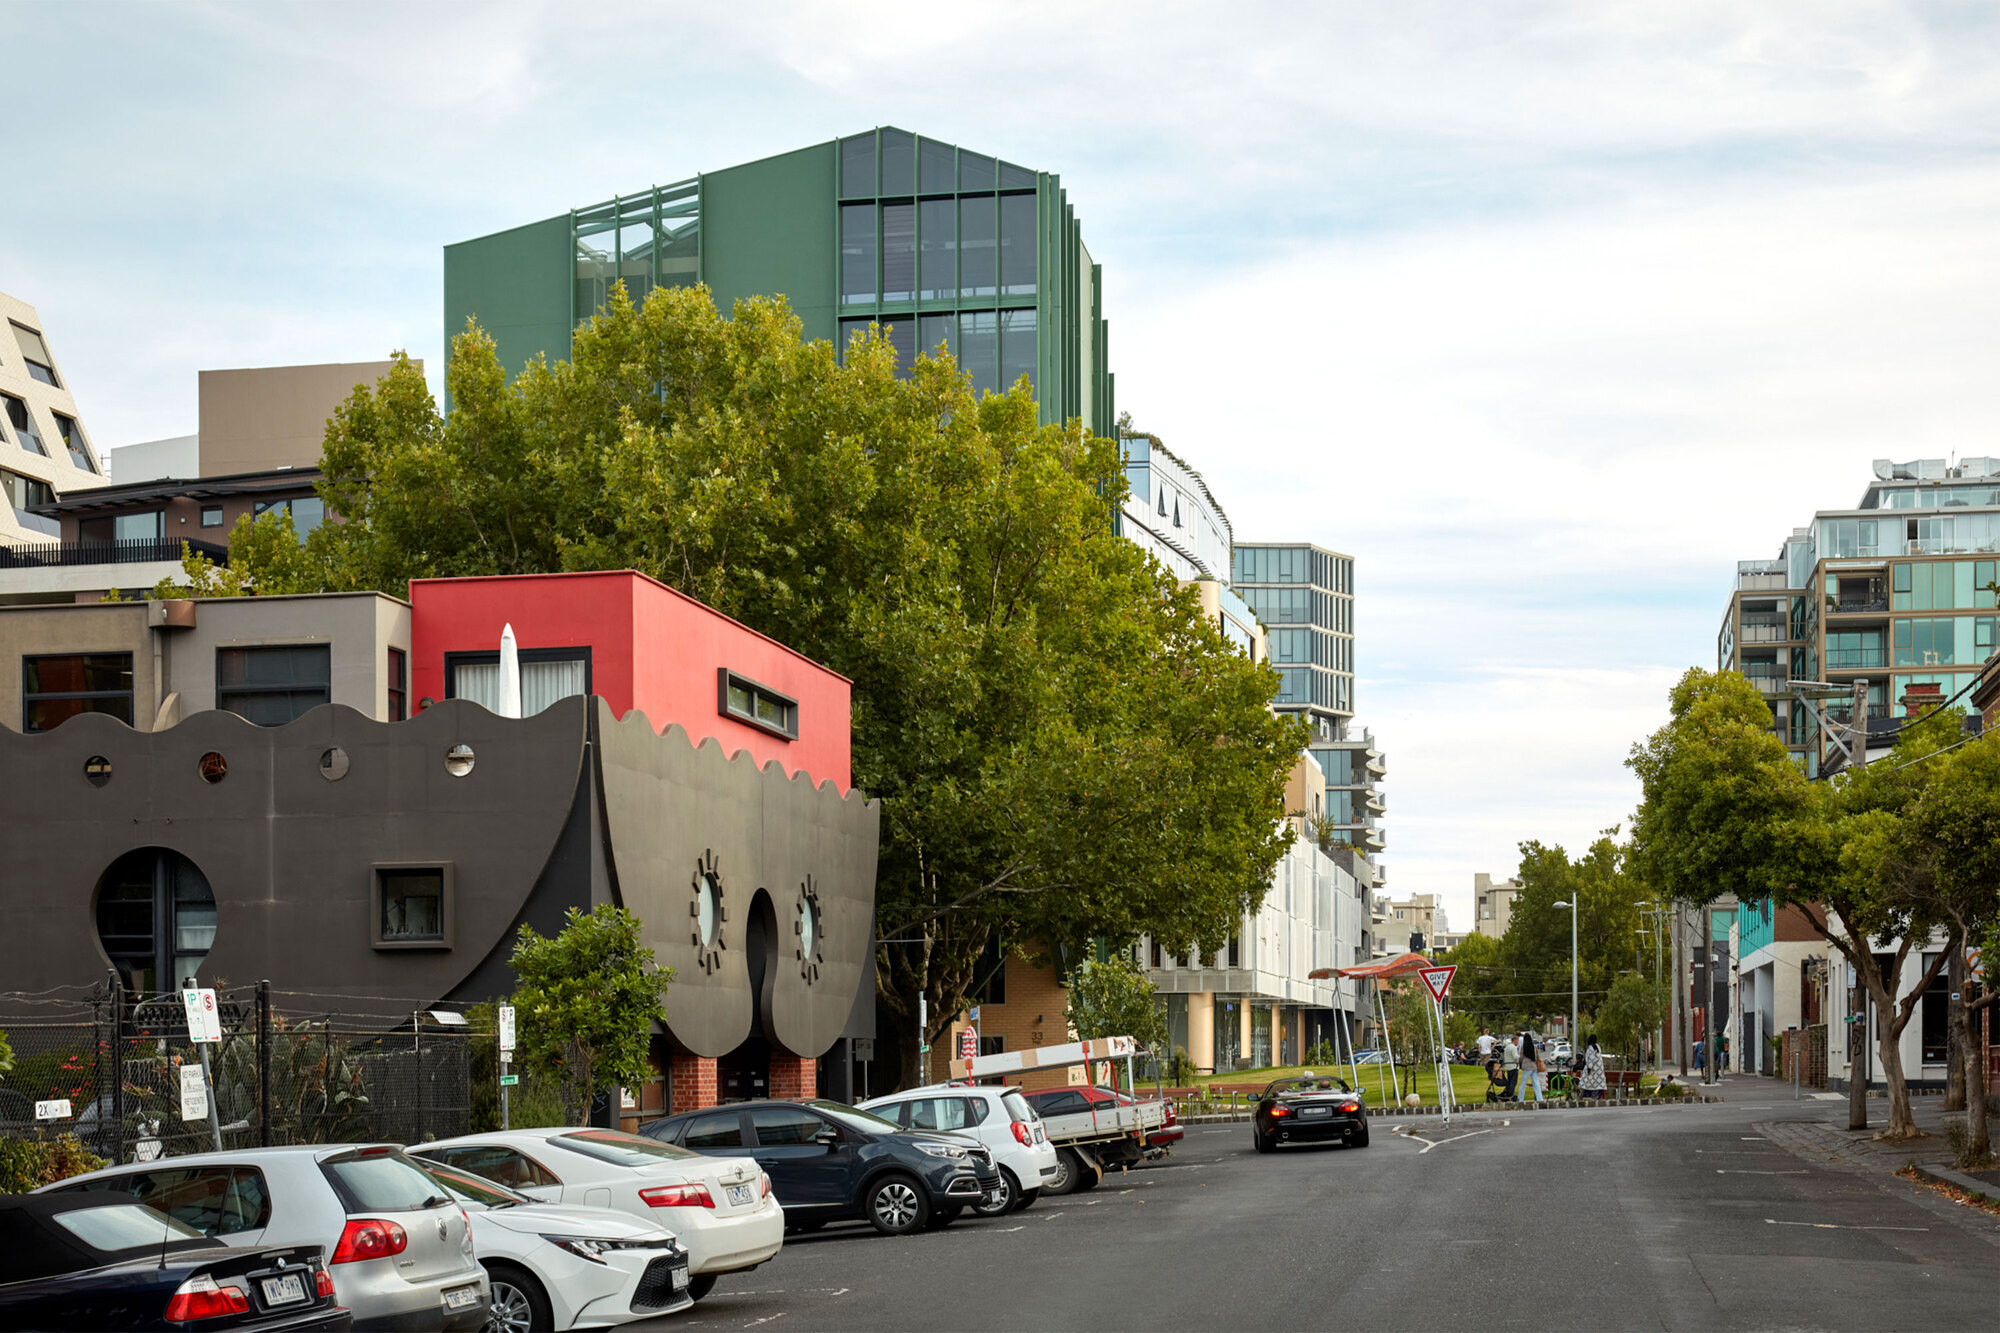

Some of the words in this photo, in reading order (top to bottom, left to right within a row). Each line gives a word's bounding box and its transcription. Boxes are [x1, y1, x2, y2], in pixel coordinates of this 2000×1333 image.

[1429, 973, 1447, 981] GIVE
[187, 992, 197, 1006] 1P
[1031, 1031, 1044, 1041] 33
